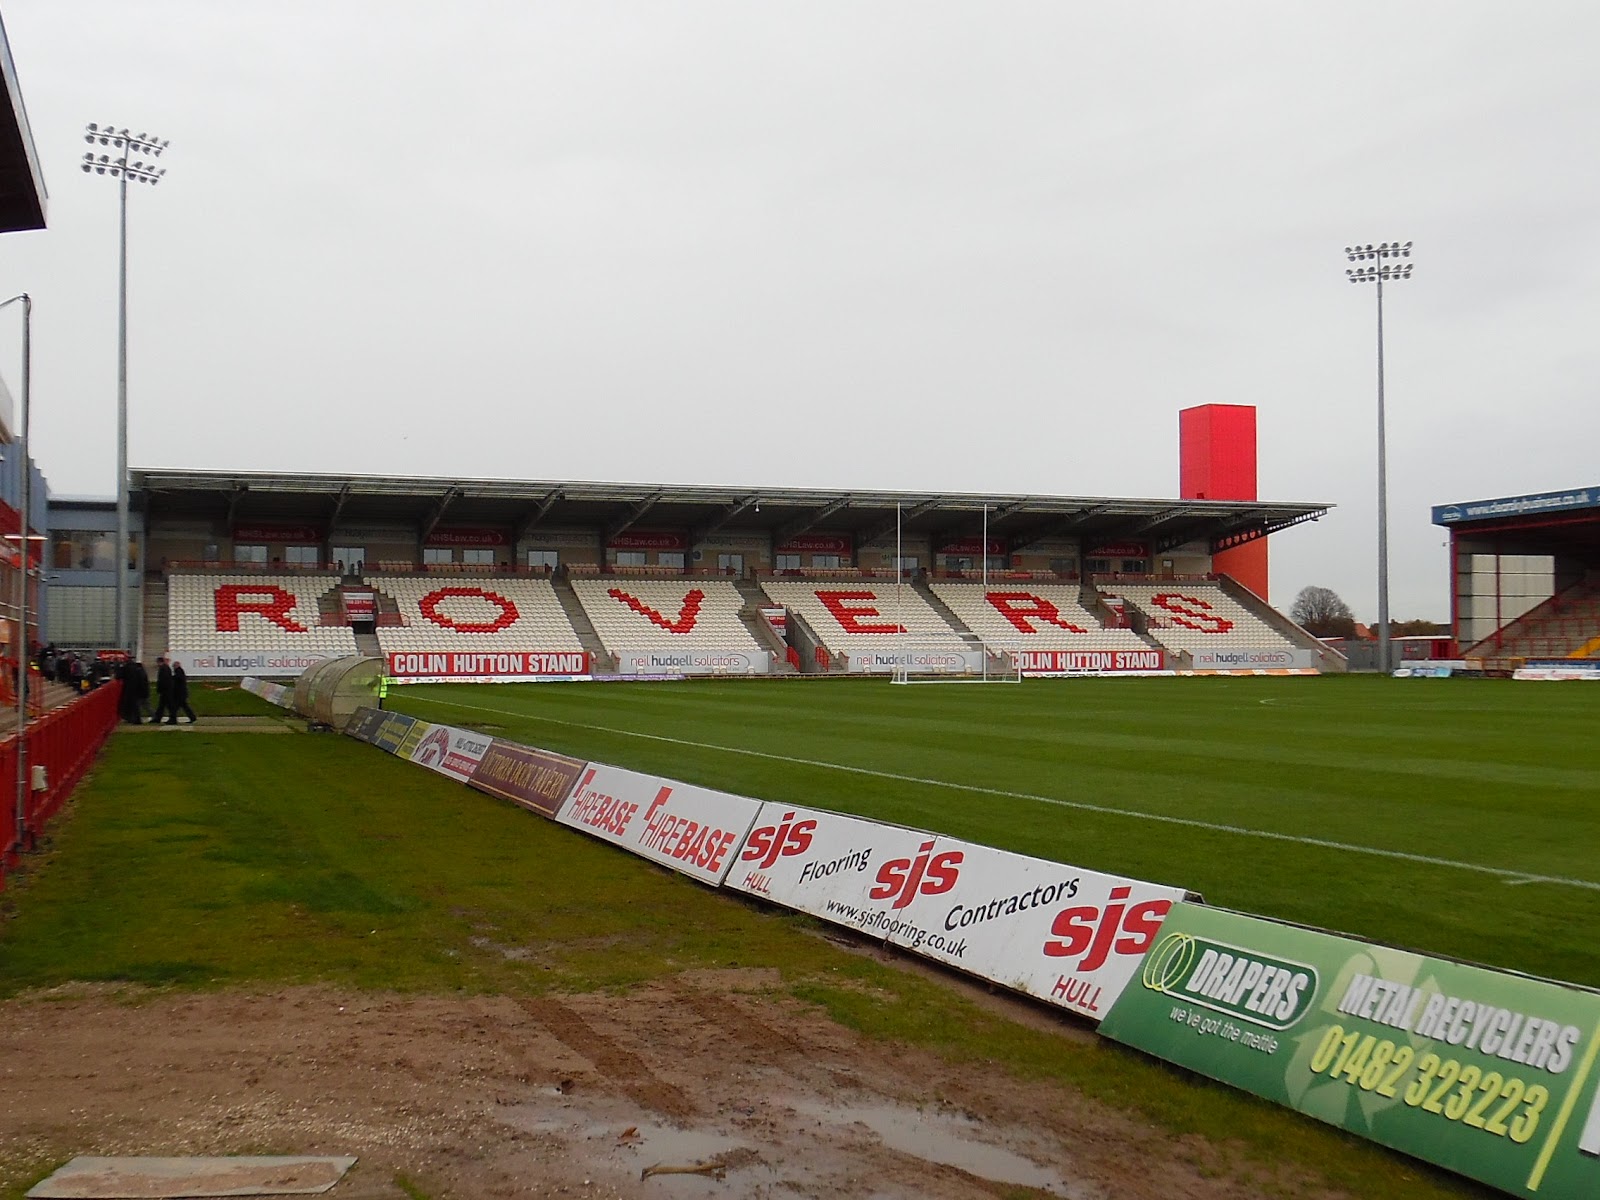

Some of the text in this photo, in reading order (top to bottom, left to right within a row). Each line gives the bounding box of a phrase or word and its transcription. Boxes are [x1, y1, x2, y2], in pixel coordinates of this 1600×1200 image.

[193, 655, 215, 668] neil
[217, 655, 265, 671] hudgell
[394, 653, 583, 673] COLIN HUTTON STAND
[630, 654, 740, 667] neil hudgell solicitors
[856, 653, 874, 665] neil
[914, 653, 957, 666] solicitors
[1011, 652, 1159, 670] COLIN HUTTON STAND
[1199, 651, 1286, 665] neil hudgell solicitors
[567, 787, 639, 837] HIREBASE
[638, 808, 736, 873] HIREBASE
[741, 811, 818, 870] sjs
[742, 870, 771, 893] HULL
[799, 848, 872, 884] Flooring
[869, 840, 965, 910] sjs
[826, 899, 968, 958] www.sjsflooring.co.uk
[944, 877, 1080, 932] Contractors
[1043, 886, 1174, 973] sjs
[1050, 974, 1103, 1013] HULL
[1184, 948, 1309, 1021] DRAPERS
[1169, 1006, 1279, 1054] we've got the mettle
[1336, 972, 1582, 1075] METAL RECYCLERS
[1310, 1024, 1550, 1145] 01482 323223
